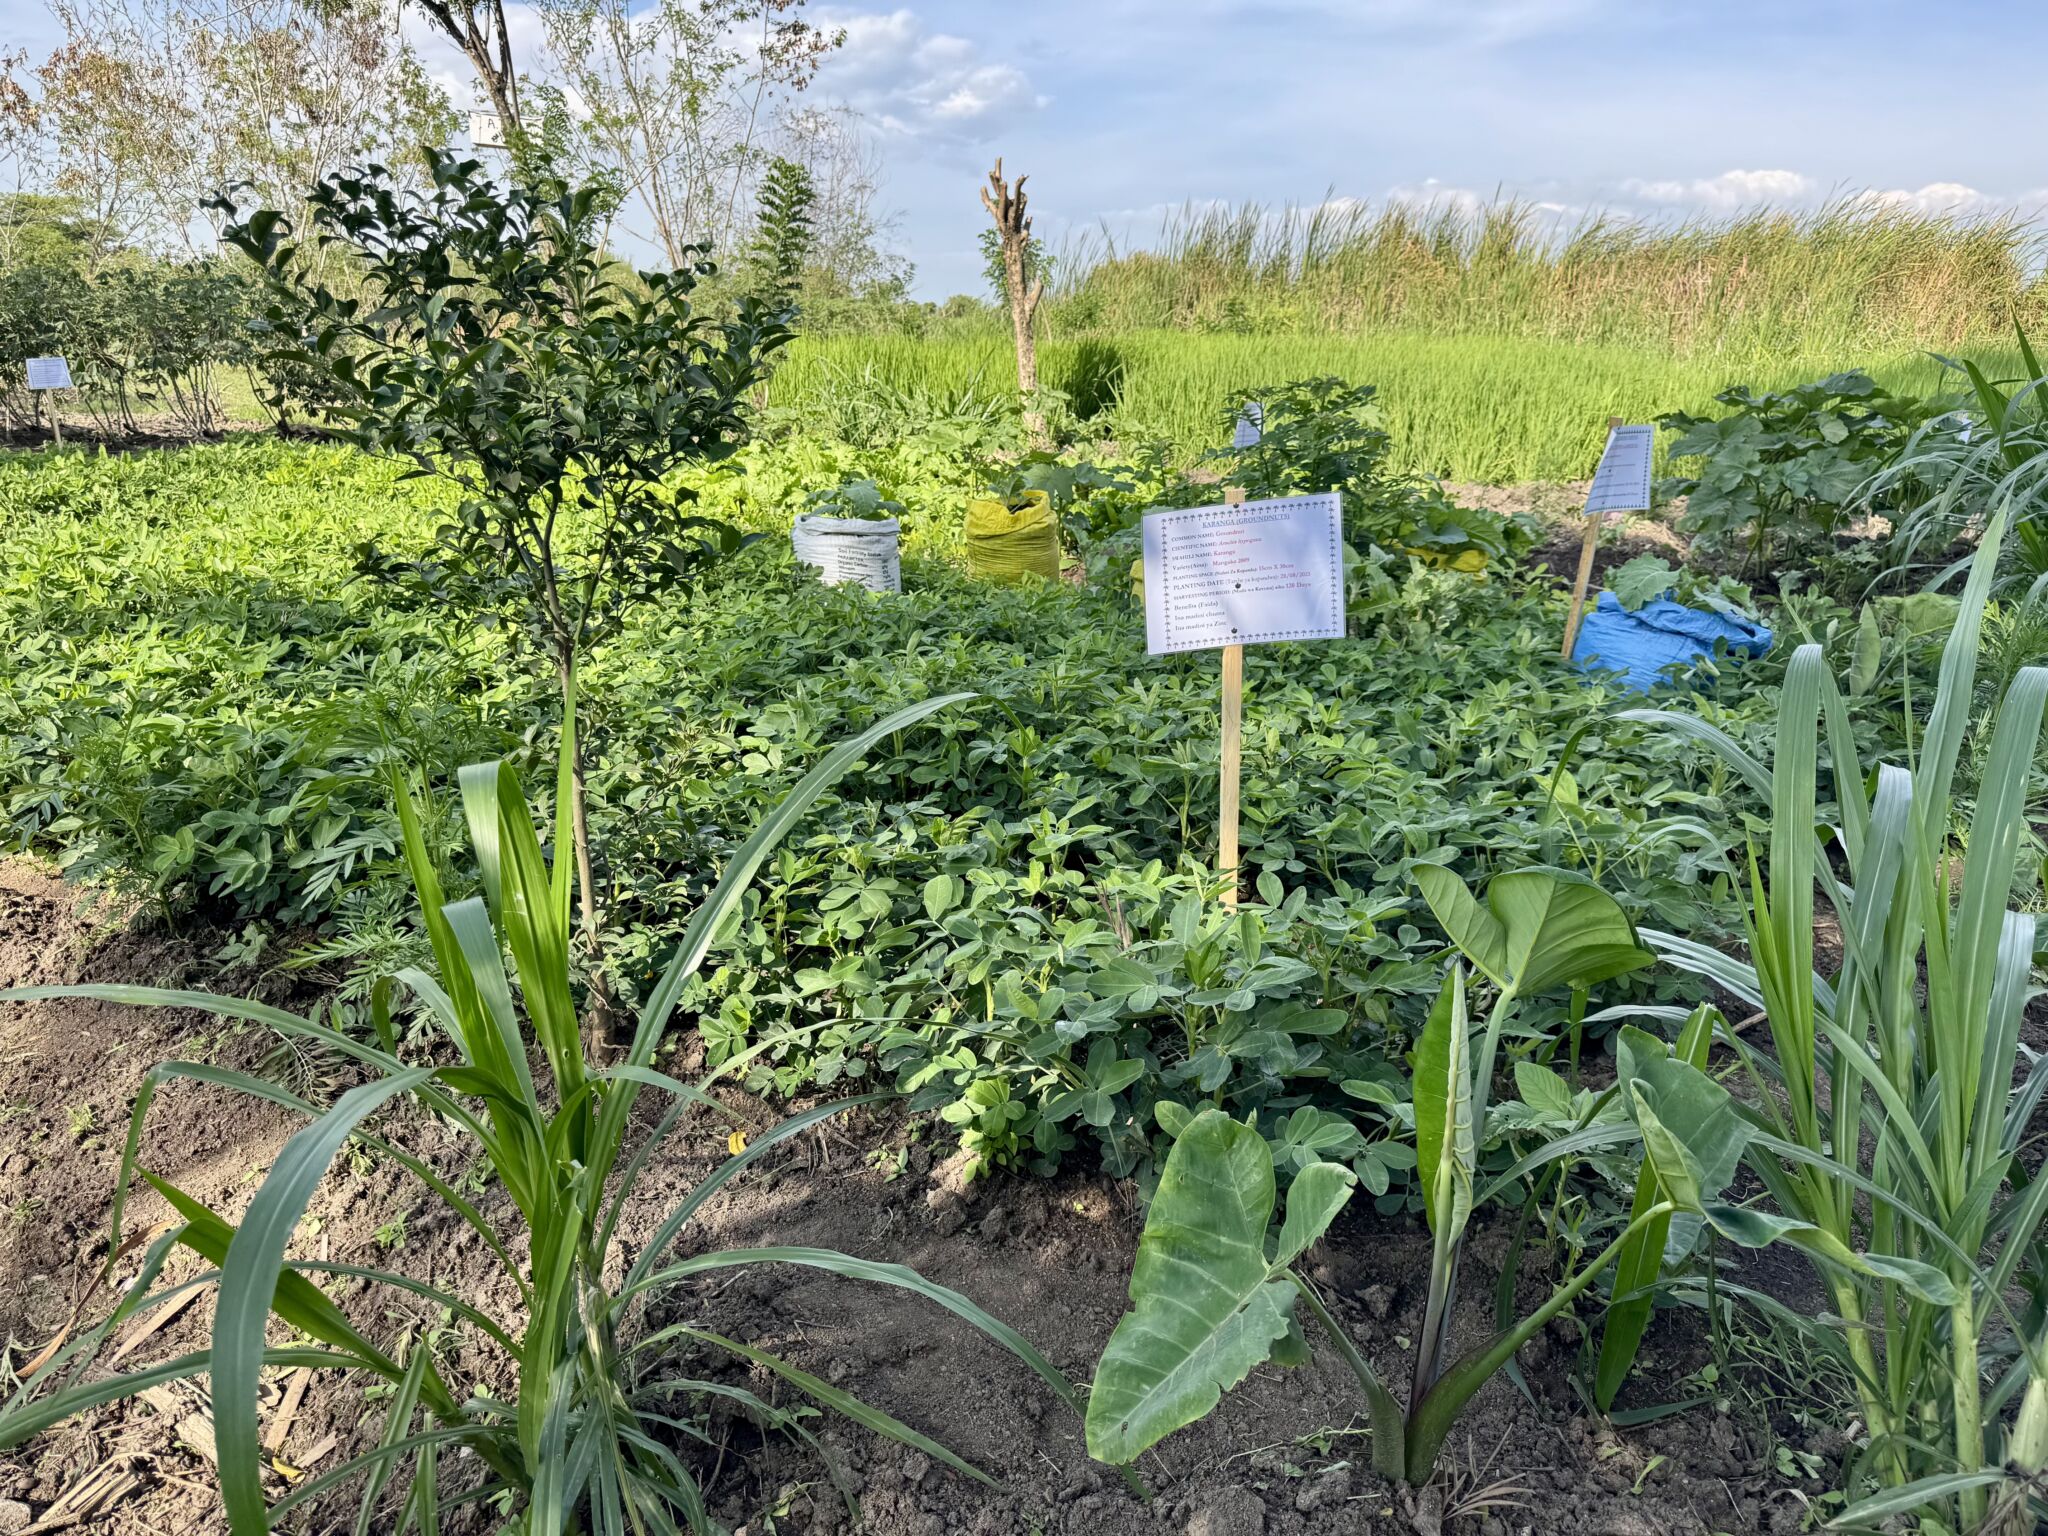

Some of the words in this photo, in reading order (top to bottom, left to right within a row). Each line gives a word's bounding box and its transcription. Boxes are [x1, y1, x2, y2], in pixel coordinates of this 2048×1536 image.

[1202, 518, 1235, 528] KARANGA
[1236, 513, 1290, 525] (GROUNDNUTS)
[1171, 534, 1196, 542] COMMON
[1173, 573, 1199, 581] PLANTING
[1173, 581, 1206, 590] PLANTING
[1207, 579, 1225, 587] DATE
[1173, 592, 1209, 601] HARVESTING
